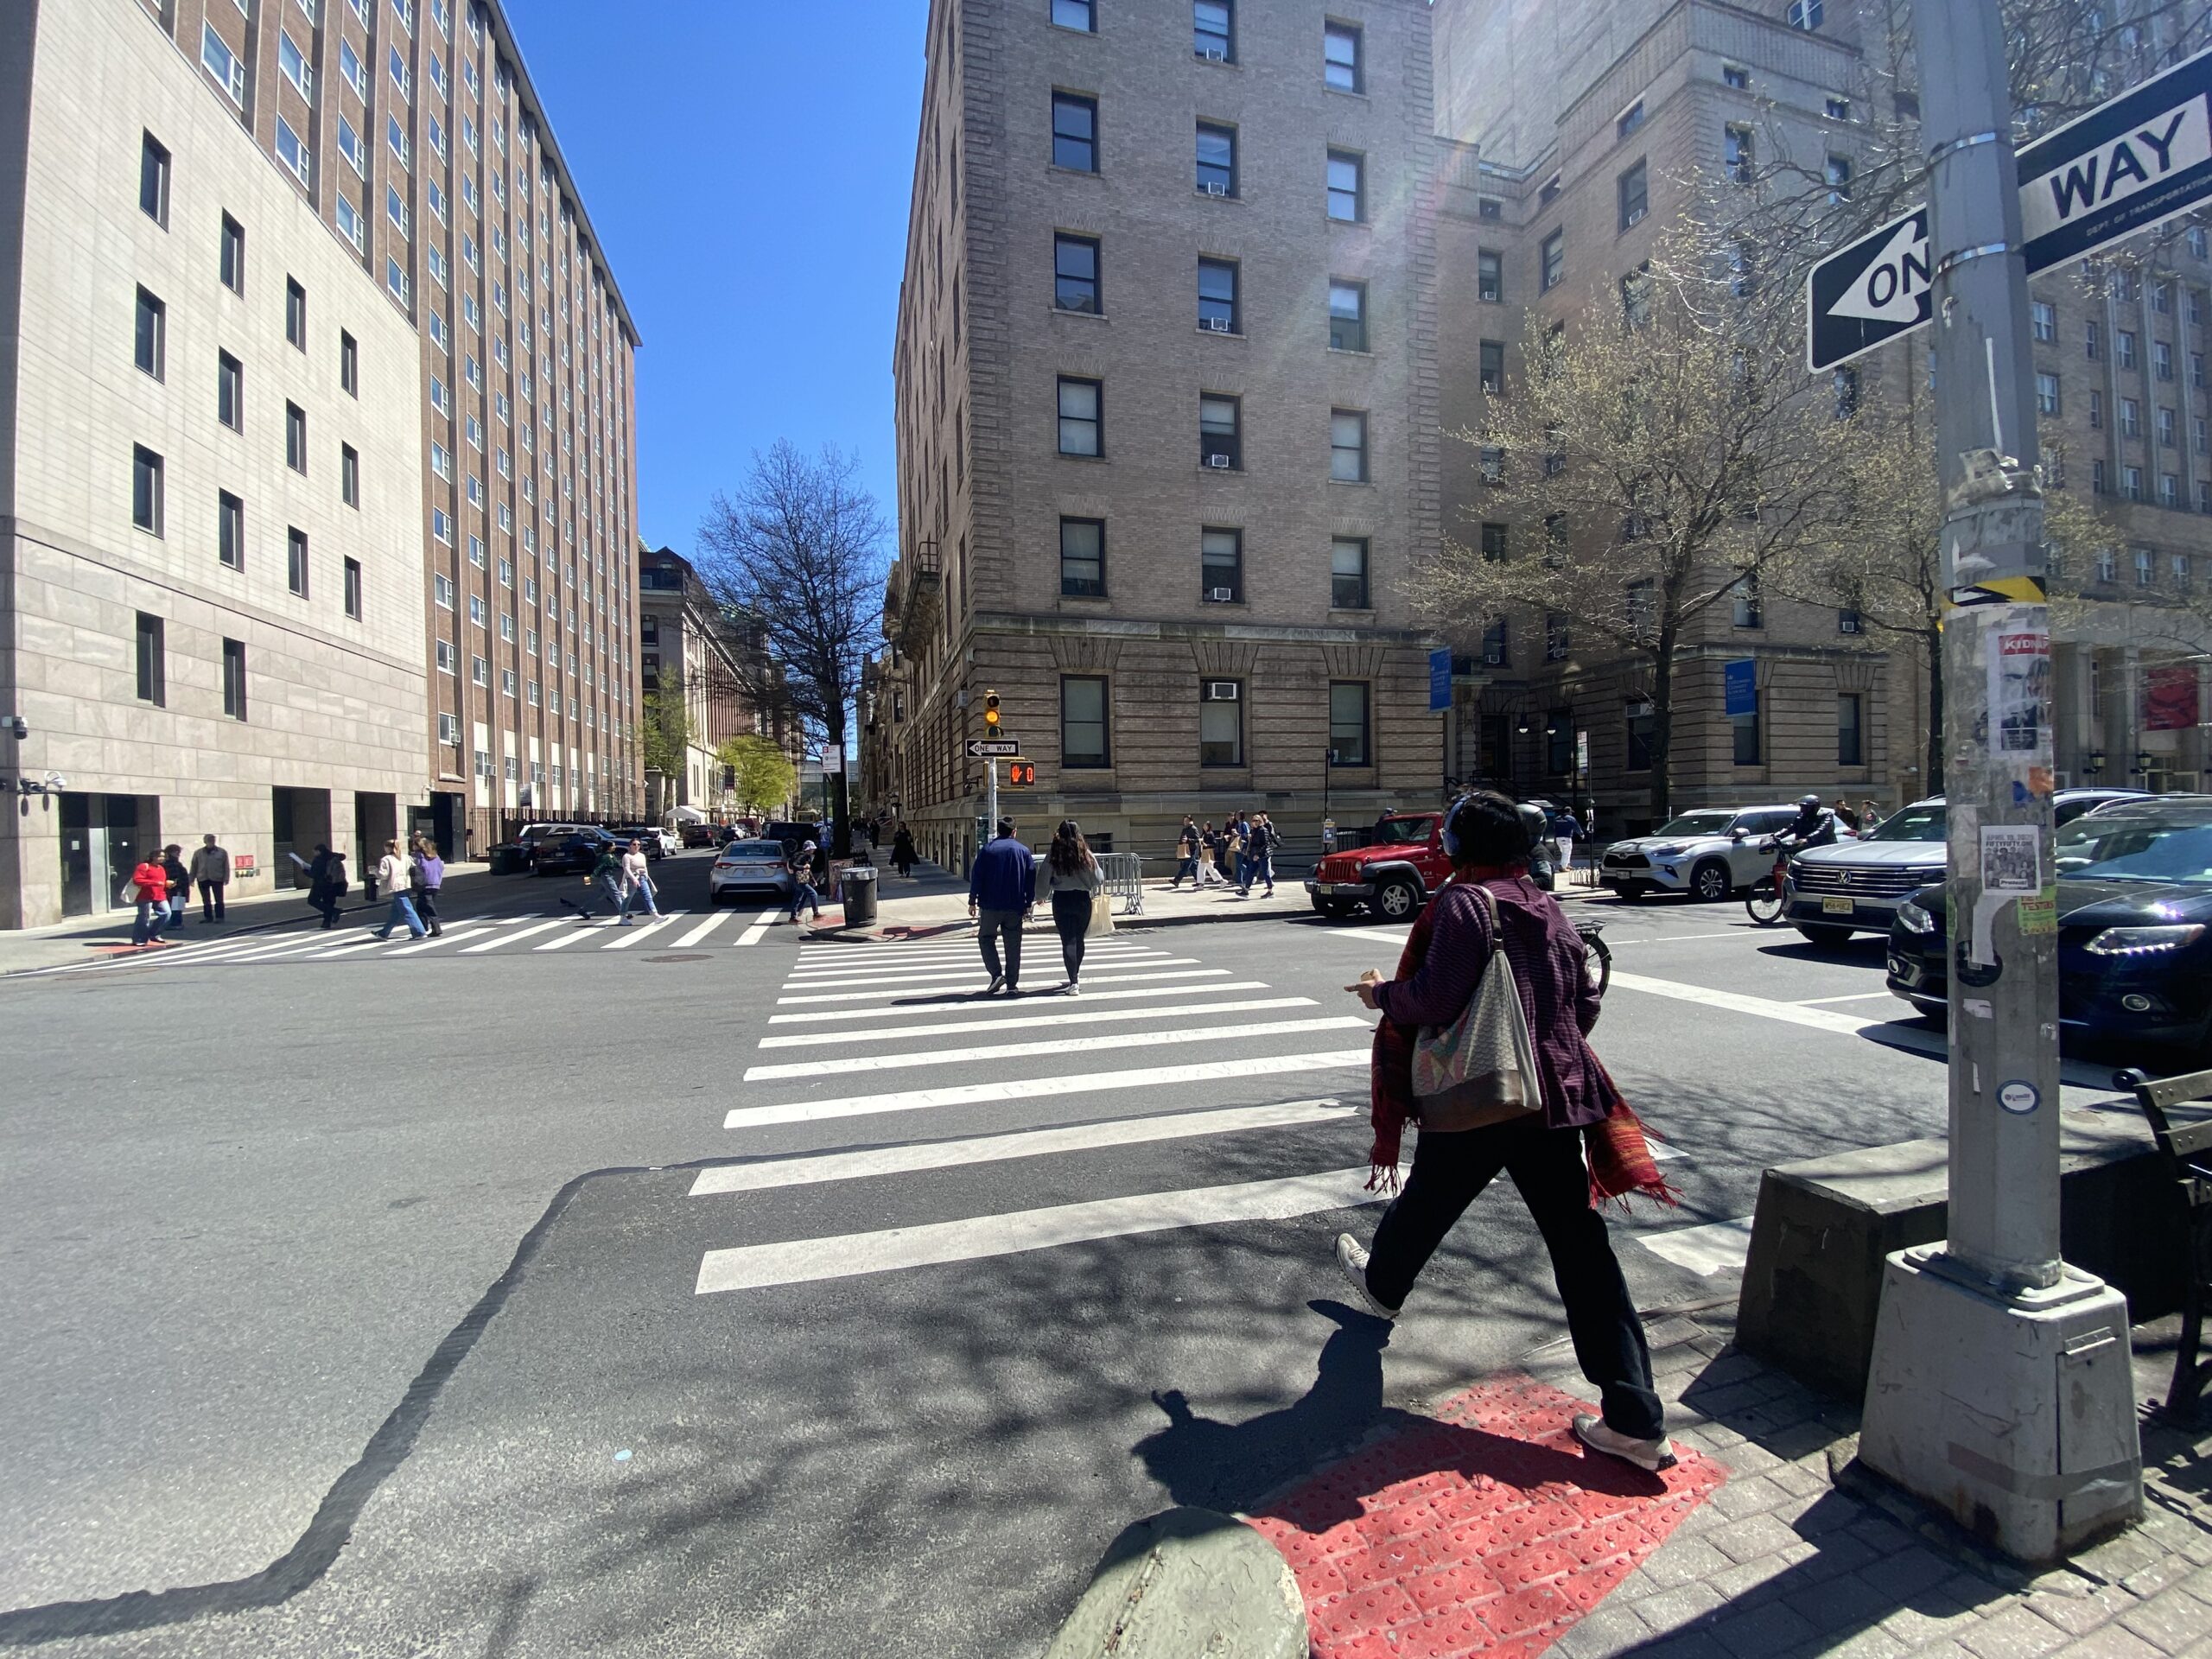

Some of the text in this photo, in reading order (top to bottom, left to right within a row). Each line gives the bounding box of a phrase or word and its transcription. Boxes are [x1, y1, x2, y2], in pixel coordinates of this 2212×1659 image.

[1867, 111, 2185, 308] ON WAY
[1027, 766, 1033, 782] 0
